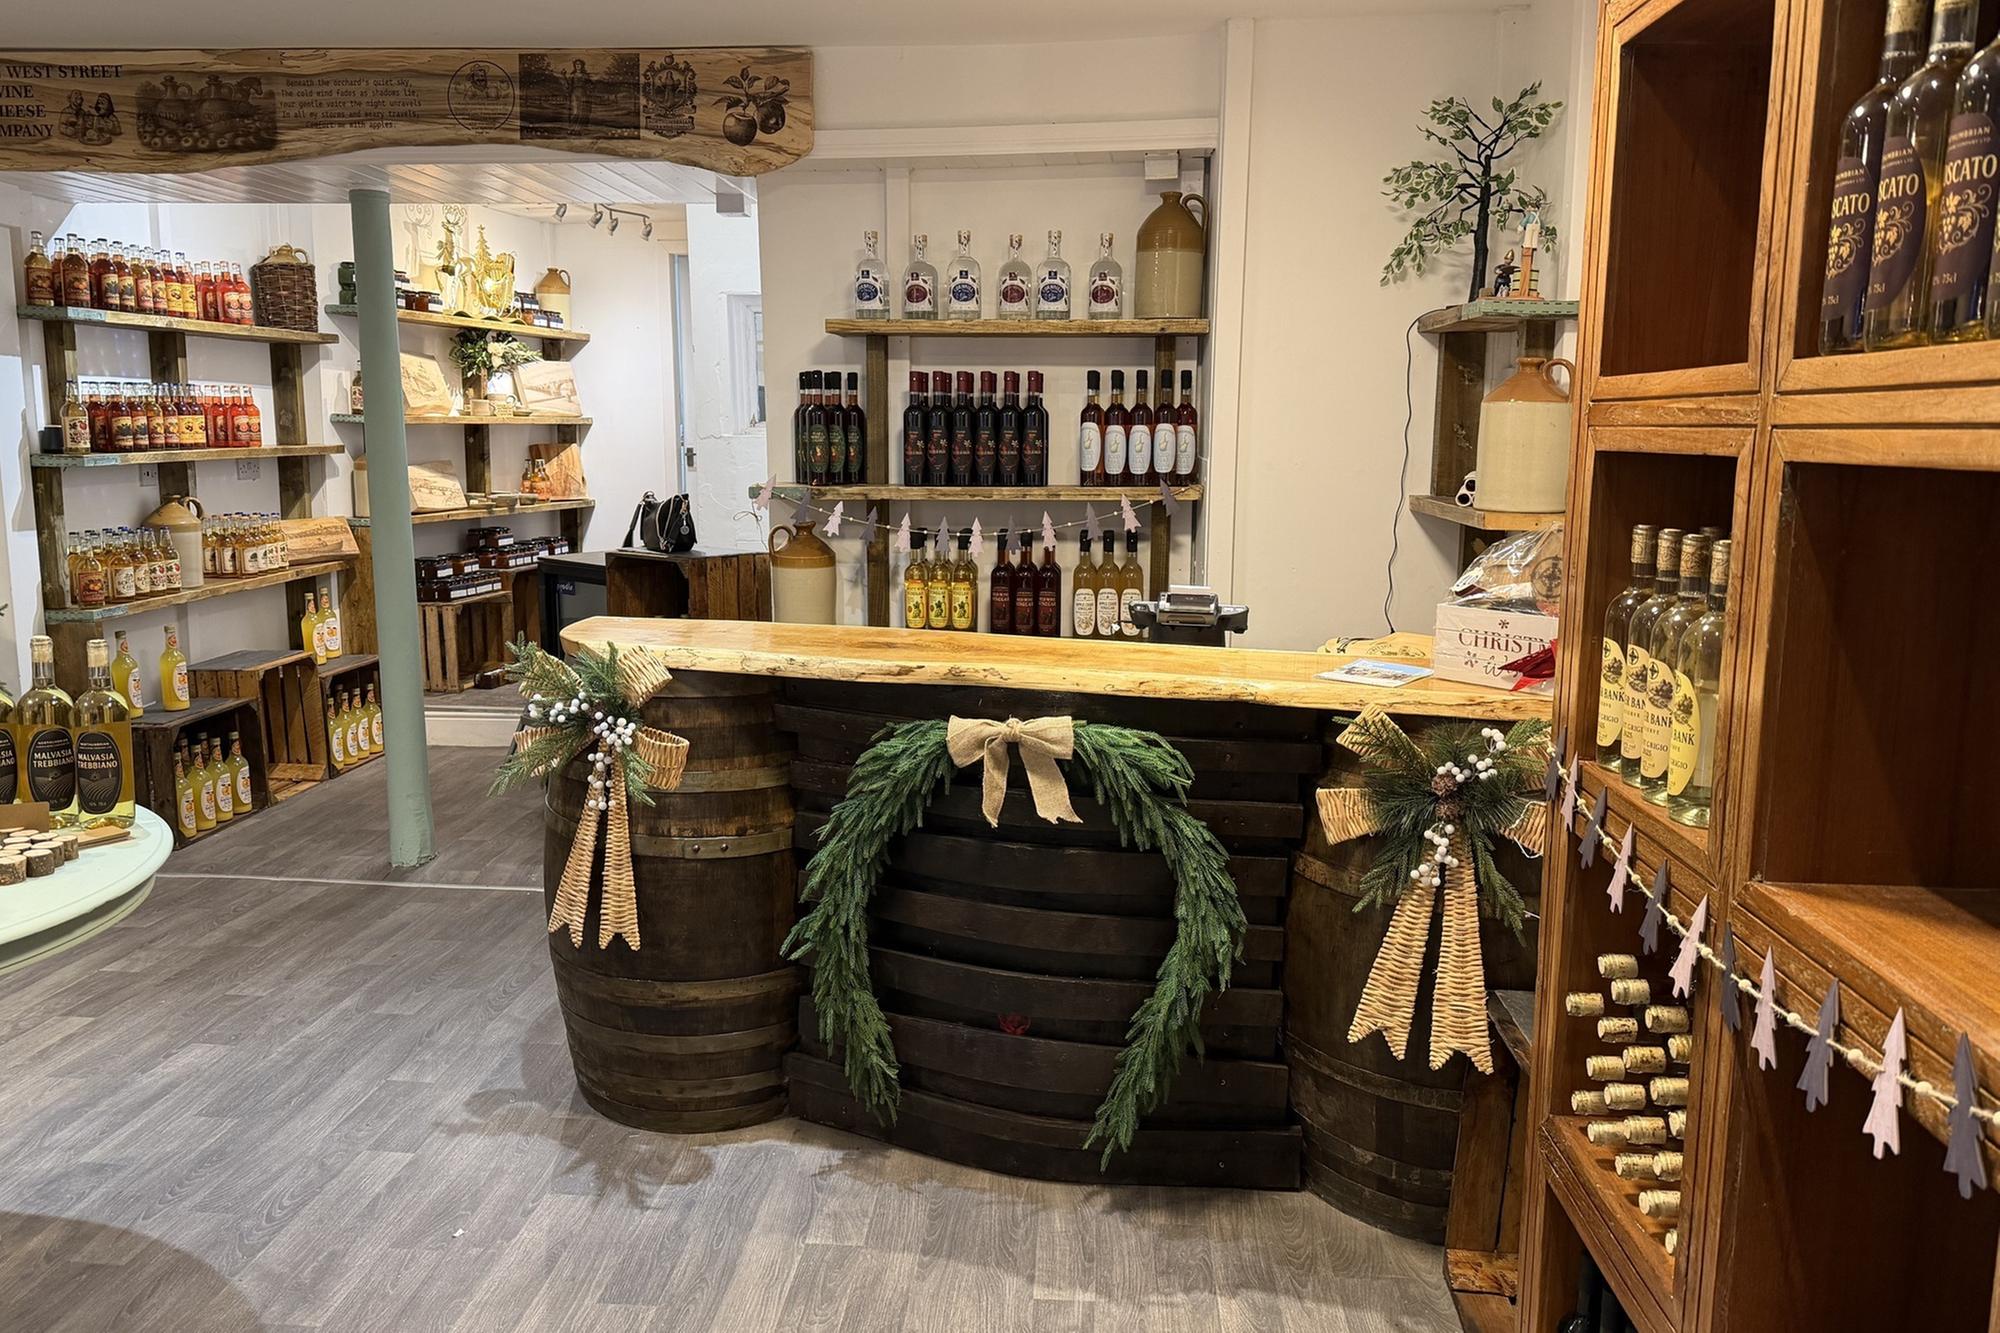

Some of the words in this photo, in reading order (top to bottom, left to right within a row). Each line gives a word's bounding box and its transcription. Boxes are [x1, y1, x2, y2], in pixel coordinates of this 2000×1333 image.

[6, 65, 52, 78] WEST
[58, 65, 122, 78] STREET
[372, 79, 393, 87] quiet
[296, 89, 313, 97] cold
[316, 89, 333, 97] wind
[336, 89, 356, 97] fades
[366, 100, 386, 109] night
[389, 99, 422, 107] unravels
[293, 110, 306, 118] all
[0, 124, 54, 137] MPANY
[1942, 154, 1998, 187] SCATO
[1878, 173, 1919, 202] SCATO
[1831, 192, 1871, 219] SCATO
[1458, 628, 1547, 655] CHRIST
[1631, 697, 1647, 710] BAN
[34, 748, 73, 760] MALVASIA
[77, 753, 115, 761] MALVASIA
[33, 755, 75, 768] TREBBIANO
[77, 761, 118, 770] TREBBIANO
